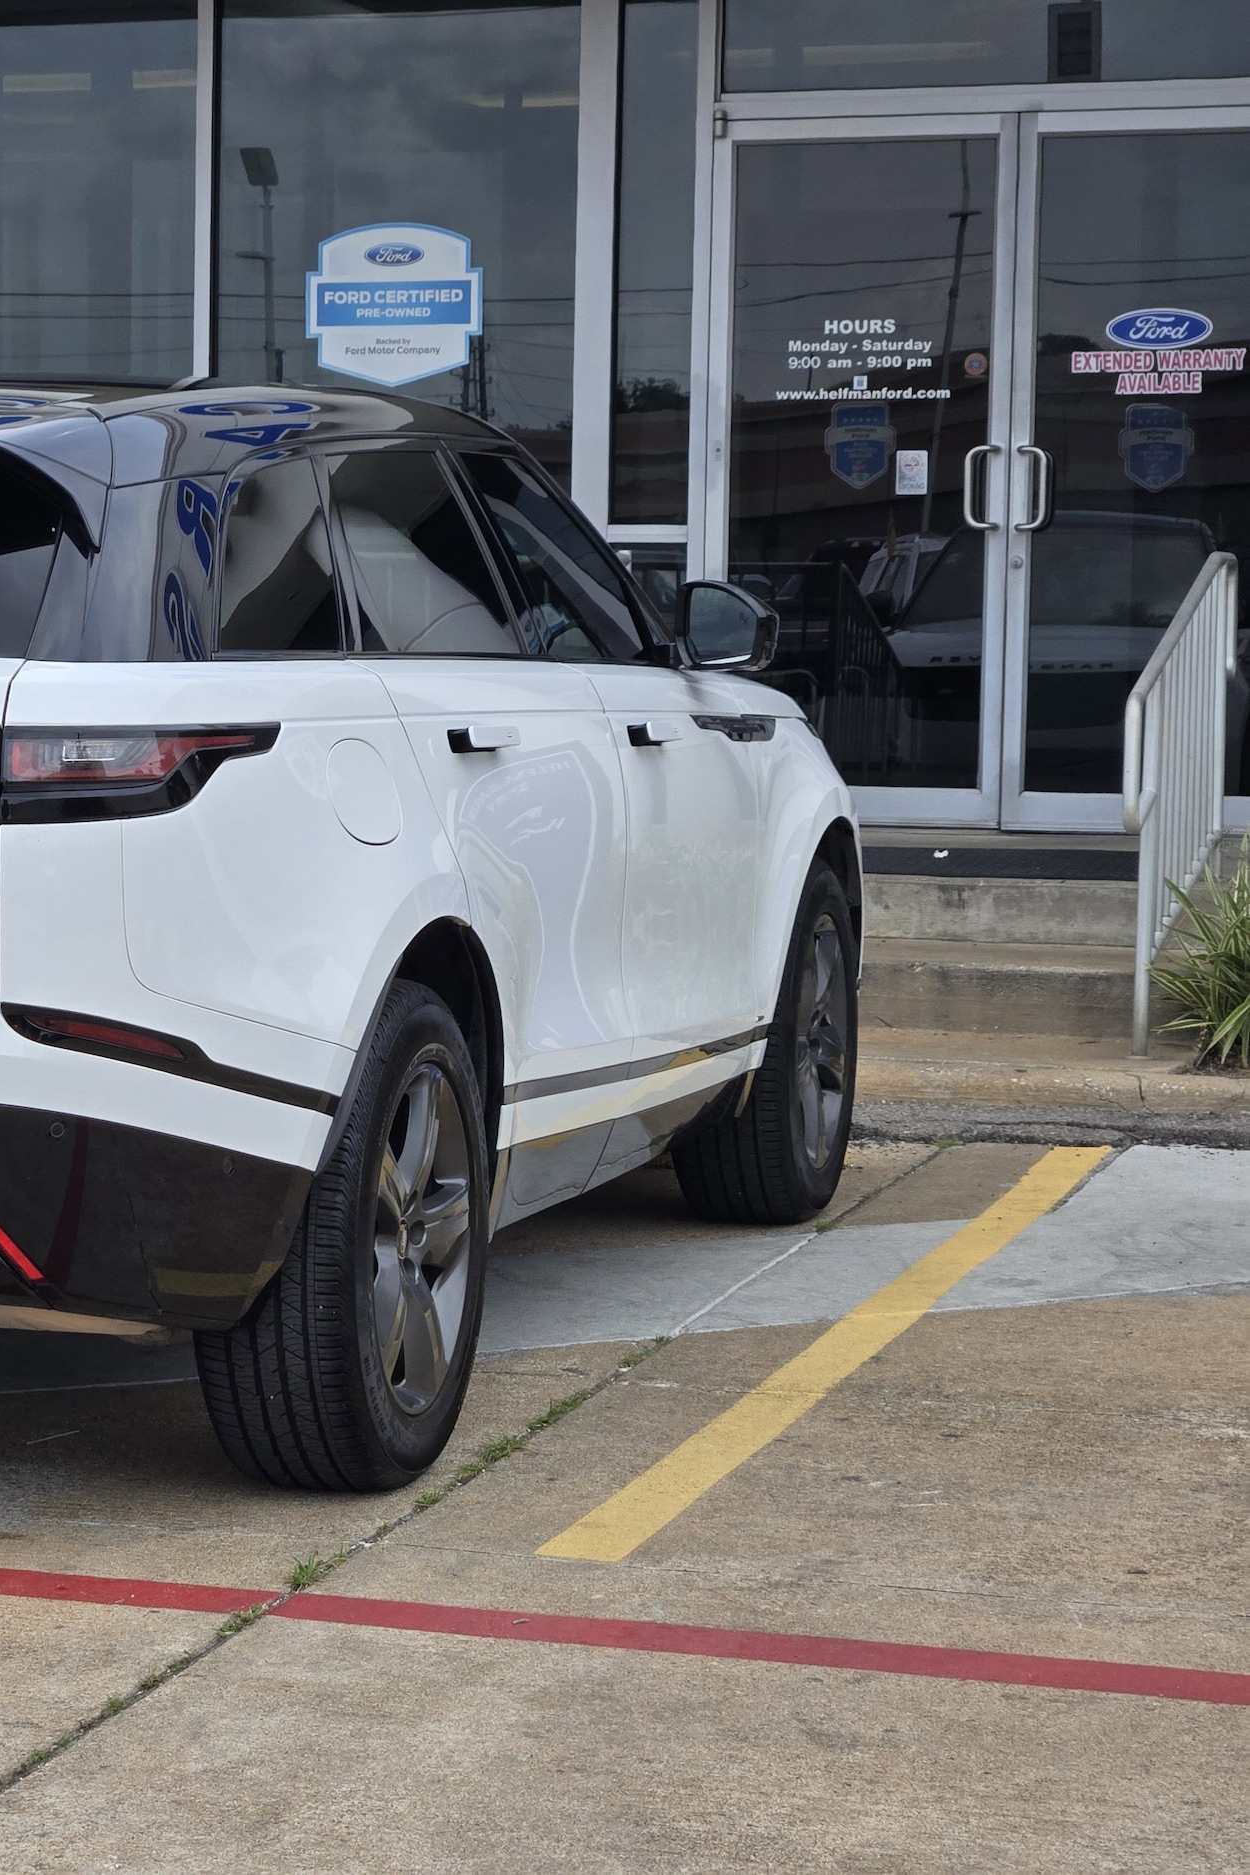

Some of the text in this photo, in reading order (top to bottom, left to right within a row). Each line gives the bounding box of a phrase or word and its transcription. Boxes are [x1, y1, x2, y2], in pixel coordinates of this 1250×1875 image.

[375, 246, 412, 264] Ford
[324, 288, 464, 305] FORD CERTIFIED
[356, 307, 431, 318] PRE-OWNED
[824, 319, 896, 335] HOURS
[1129, 315, 1190, 340] Ford
[375, 337, 411, 346] Backed by
[788, 340, 849, 354] Monday
[862, 339, 933, 353] Saturday
[345, 345, 441, 357] Ford Motor Company
[788, 356, 821, 369] 9:00
[827, 358, 852, 368] am
[867, 356, 902, 368] 9:00
[906, 356, 932, 370] pm
[1071, 348, 1247, 373] EXTENDED WARRANTY
[1115, 372, 1203, 395] AVAILABLE
[776, 387, 951, 400] www.helfmanford.com
